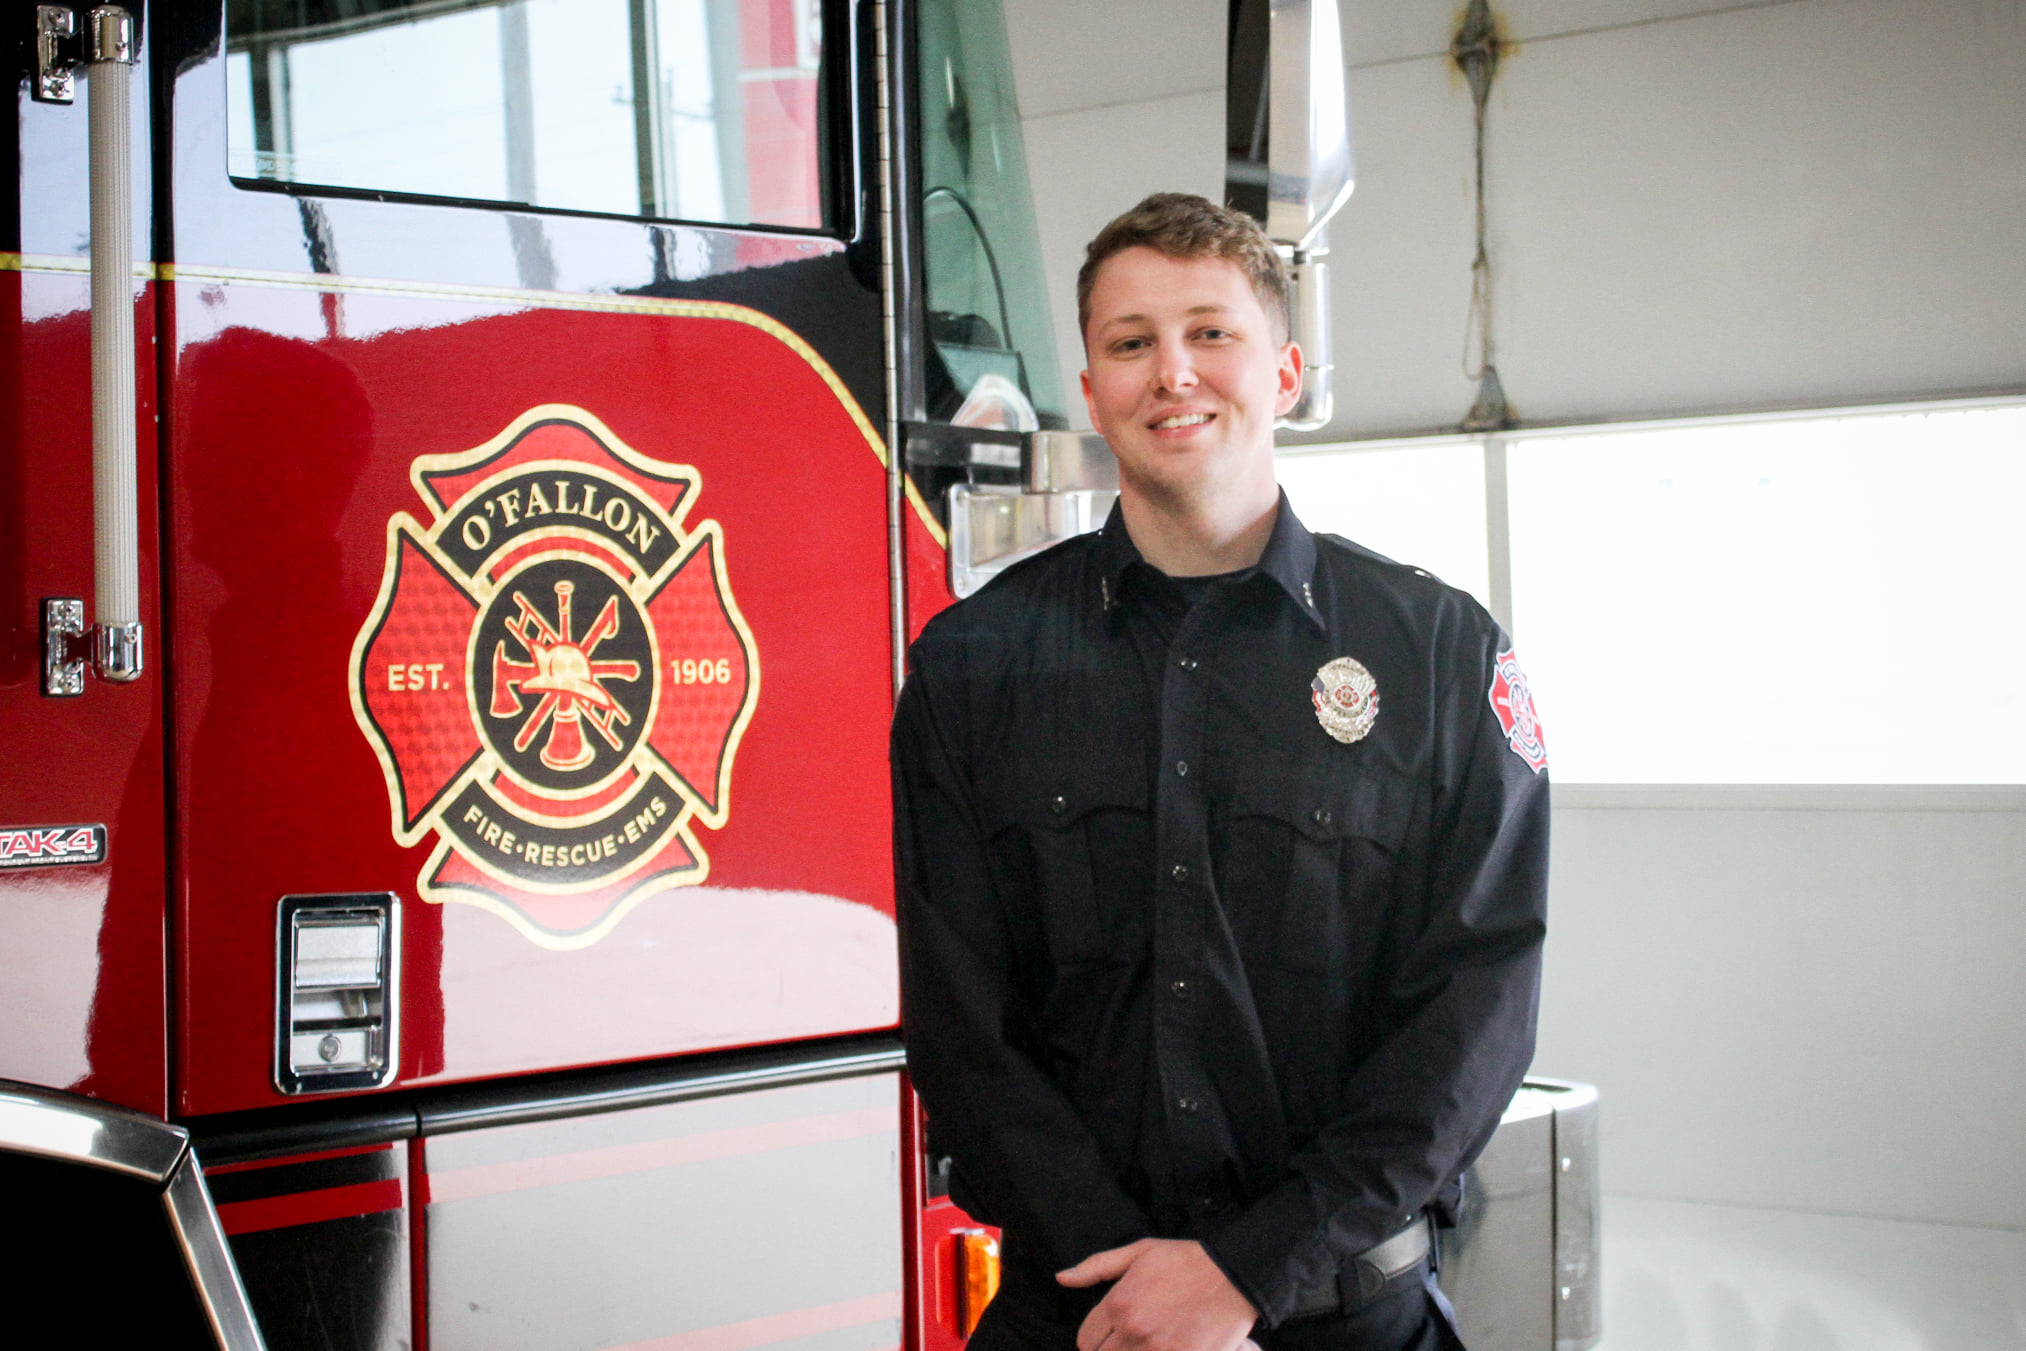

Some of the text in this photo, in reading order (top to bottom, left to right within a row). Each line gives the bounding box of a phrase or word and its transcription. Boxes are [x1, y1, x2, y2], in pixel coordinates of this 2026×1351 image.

[462, 480, 661, 554] O'FALLON
[388, 663, 449, 691] EST.
[670, 658, 731, 685] 1906
